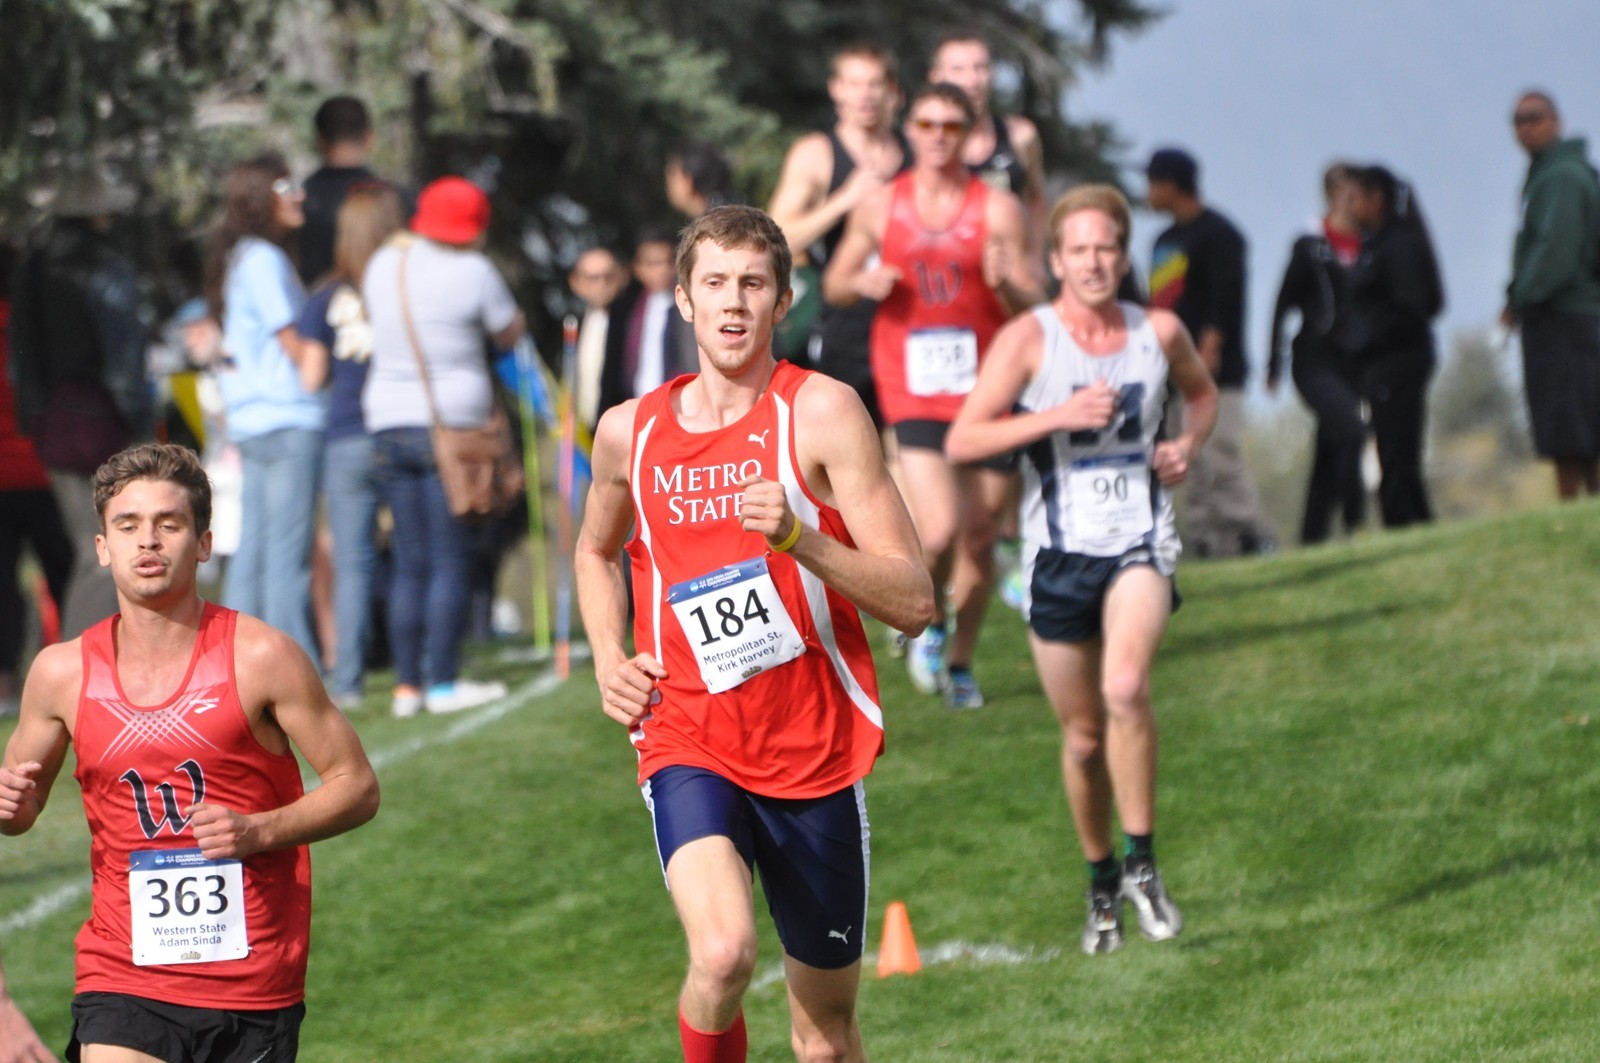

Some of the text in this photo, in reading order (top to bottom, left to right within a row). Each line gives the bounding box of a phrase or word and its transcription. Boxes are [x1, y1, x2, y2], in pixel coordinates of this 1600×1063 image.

[914, 260, 963, 308] W
[652, 458, 762, 494] METRO
[1092, 473, 1129, 504] 90
[668, 492, 746, 525] STATE
[689, 588, 771, 646] 184
[703, 630, 782, 665] Metropolitan St.
[717, 660, 738, 673] Kirk
[739, 645, 776, 665] Harvey
[119, 758, 205, 840] W
[146, 875, 229, 918] 363
[152, 923, 227, 936] Western State
[159, 935, 222, 947] Adam Sinda
